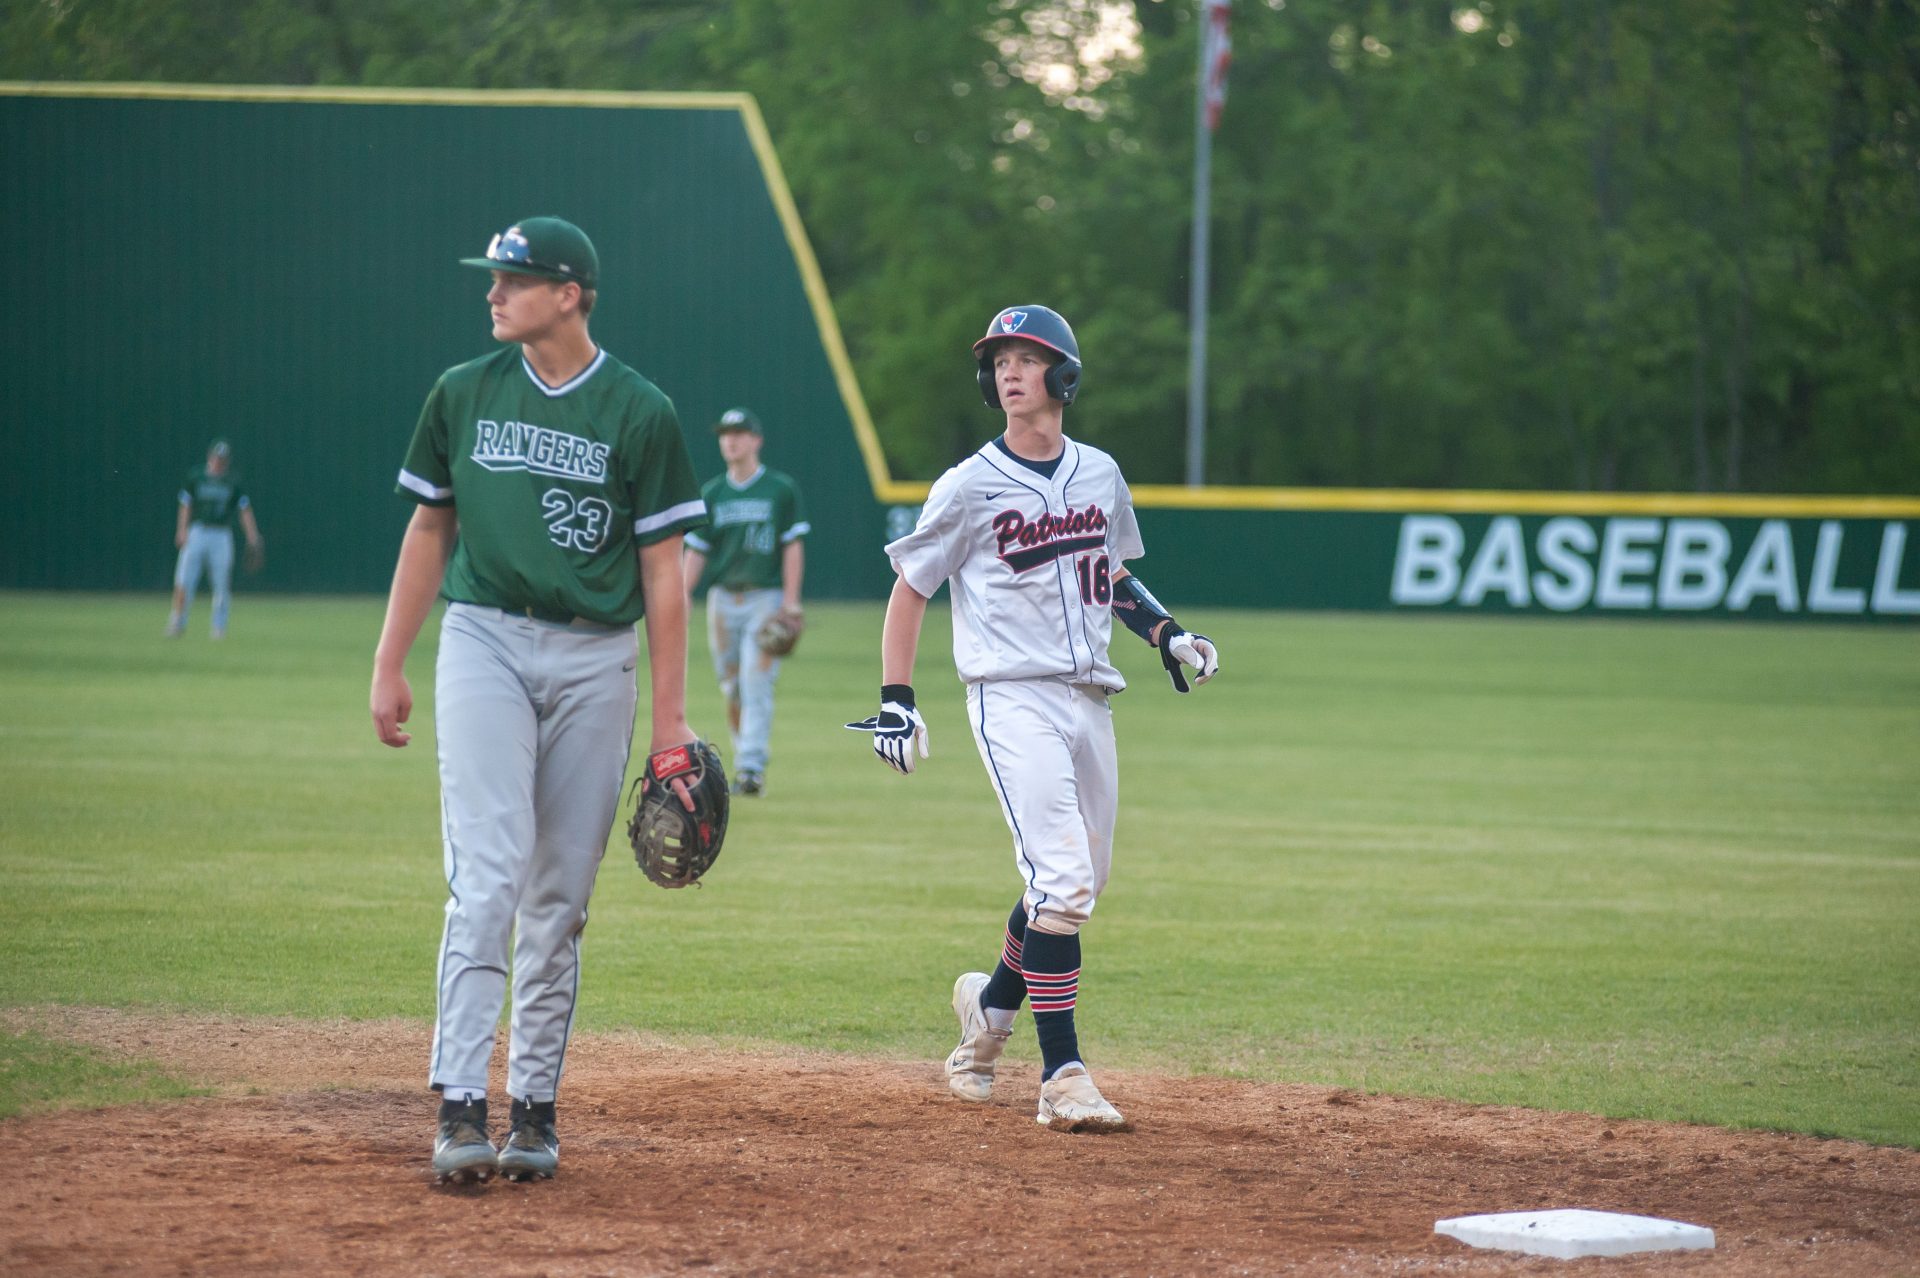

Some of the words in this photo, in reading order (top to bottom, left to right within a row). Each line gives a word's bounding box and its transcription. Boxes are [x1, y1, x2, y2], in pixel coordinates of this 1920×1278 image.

[472, 419, 611, 480] RANGERS
[541, 488, 613, 553] 23
[992, 504, 1108, 556] Patriots
[1077, 555, 1112, 606] 16
[1391, 514, 1920, 614] BASEBALL
